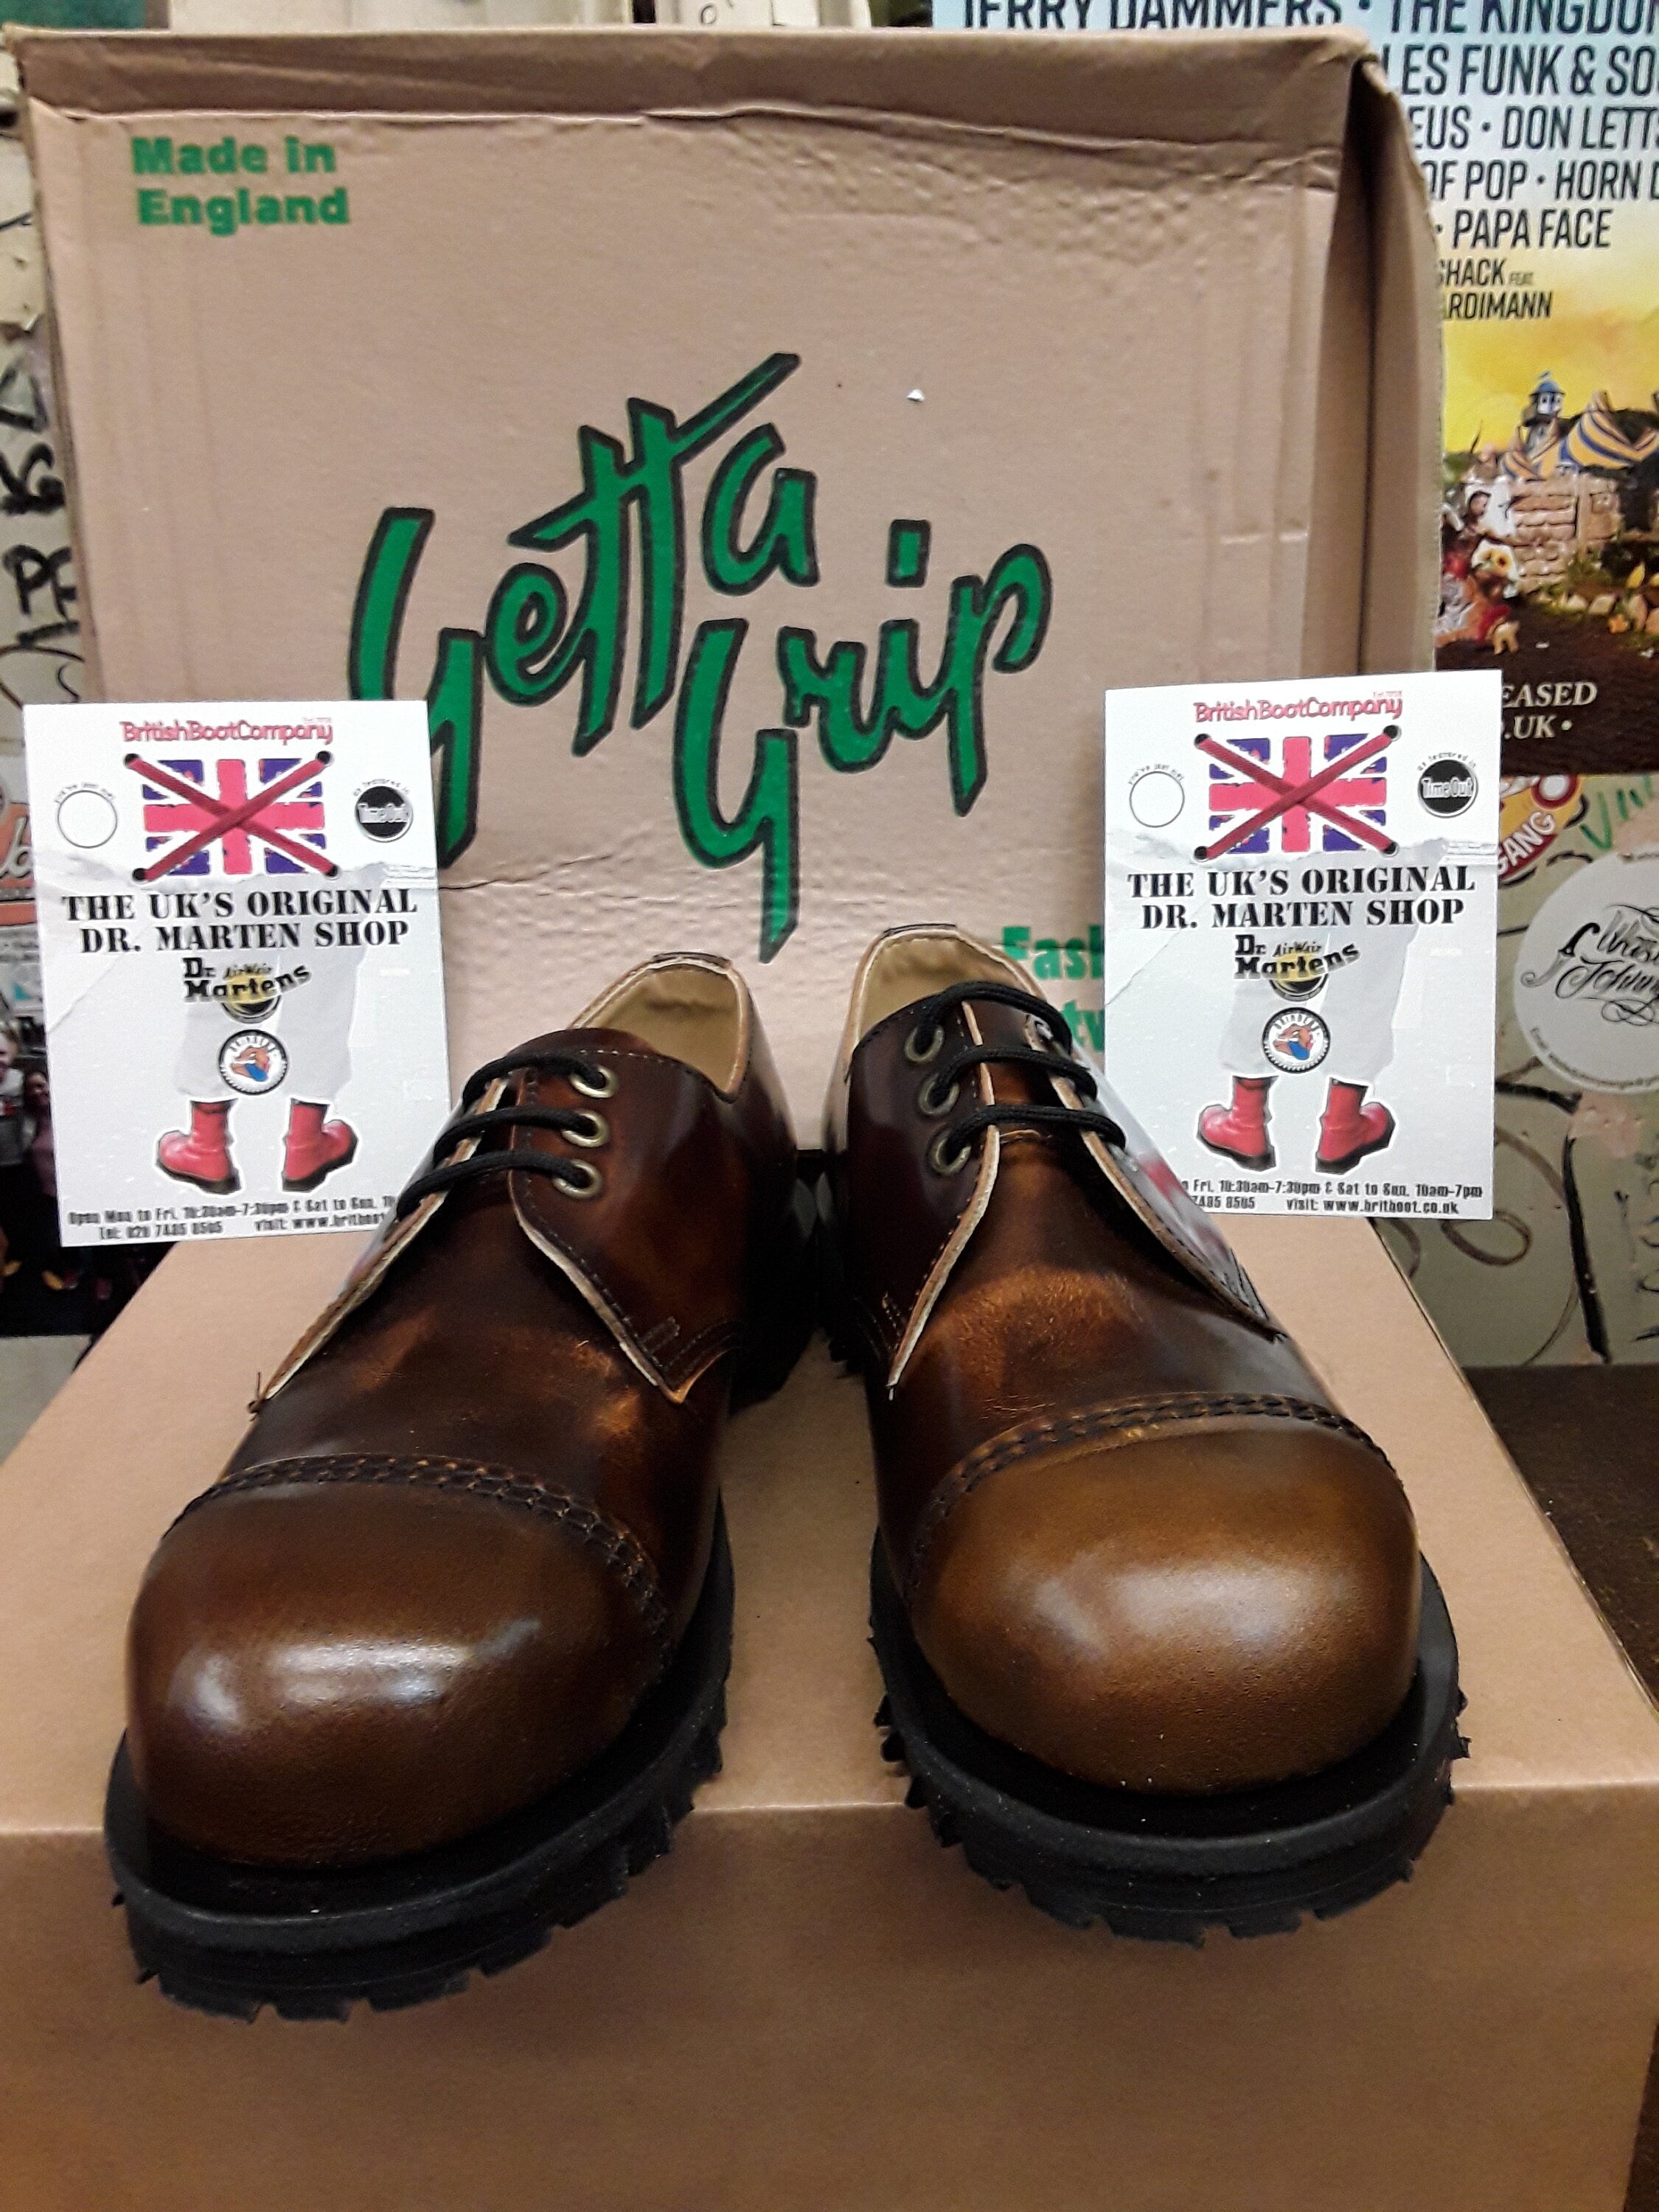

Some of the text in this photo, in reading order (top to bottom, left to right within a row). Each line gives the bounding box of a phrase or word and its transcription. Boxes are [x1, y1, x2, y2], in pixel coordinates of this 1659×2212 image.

[1481, 0, 1659, 34] KINGDO
[1458, 44, 1564, 95] FUNK
[1570, 44, 1596, 96] &
[1605, 44, 1659, 96] SO
[1501, 105, 1573, 150] DON
[1580, 105, 1659, 150] LETT
[131, 135, 337, 175] Made in
[1464, 159, 1528, 201] POP
[1554, 159, 1642, 201] HORN
[137, 187, 349, 237] England
[1453, 209, 1613, 249] PAPA FACE
[672, 518, 1053, 964] Grip
[1127, 865, 1476, 899] THE UK'S ORIGINAL
[61, 888, 418, 922] THE UK'S ORIGINAL
[1141, 897, 1465, 930] DR. MARTEN SHOP
[80, 919, 409, 953] DR. MARTEN SHOP
[1234, 943, 1360, 978] Martens
[184, 964, 313, 1000] Martens
